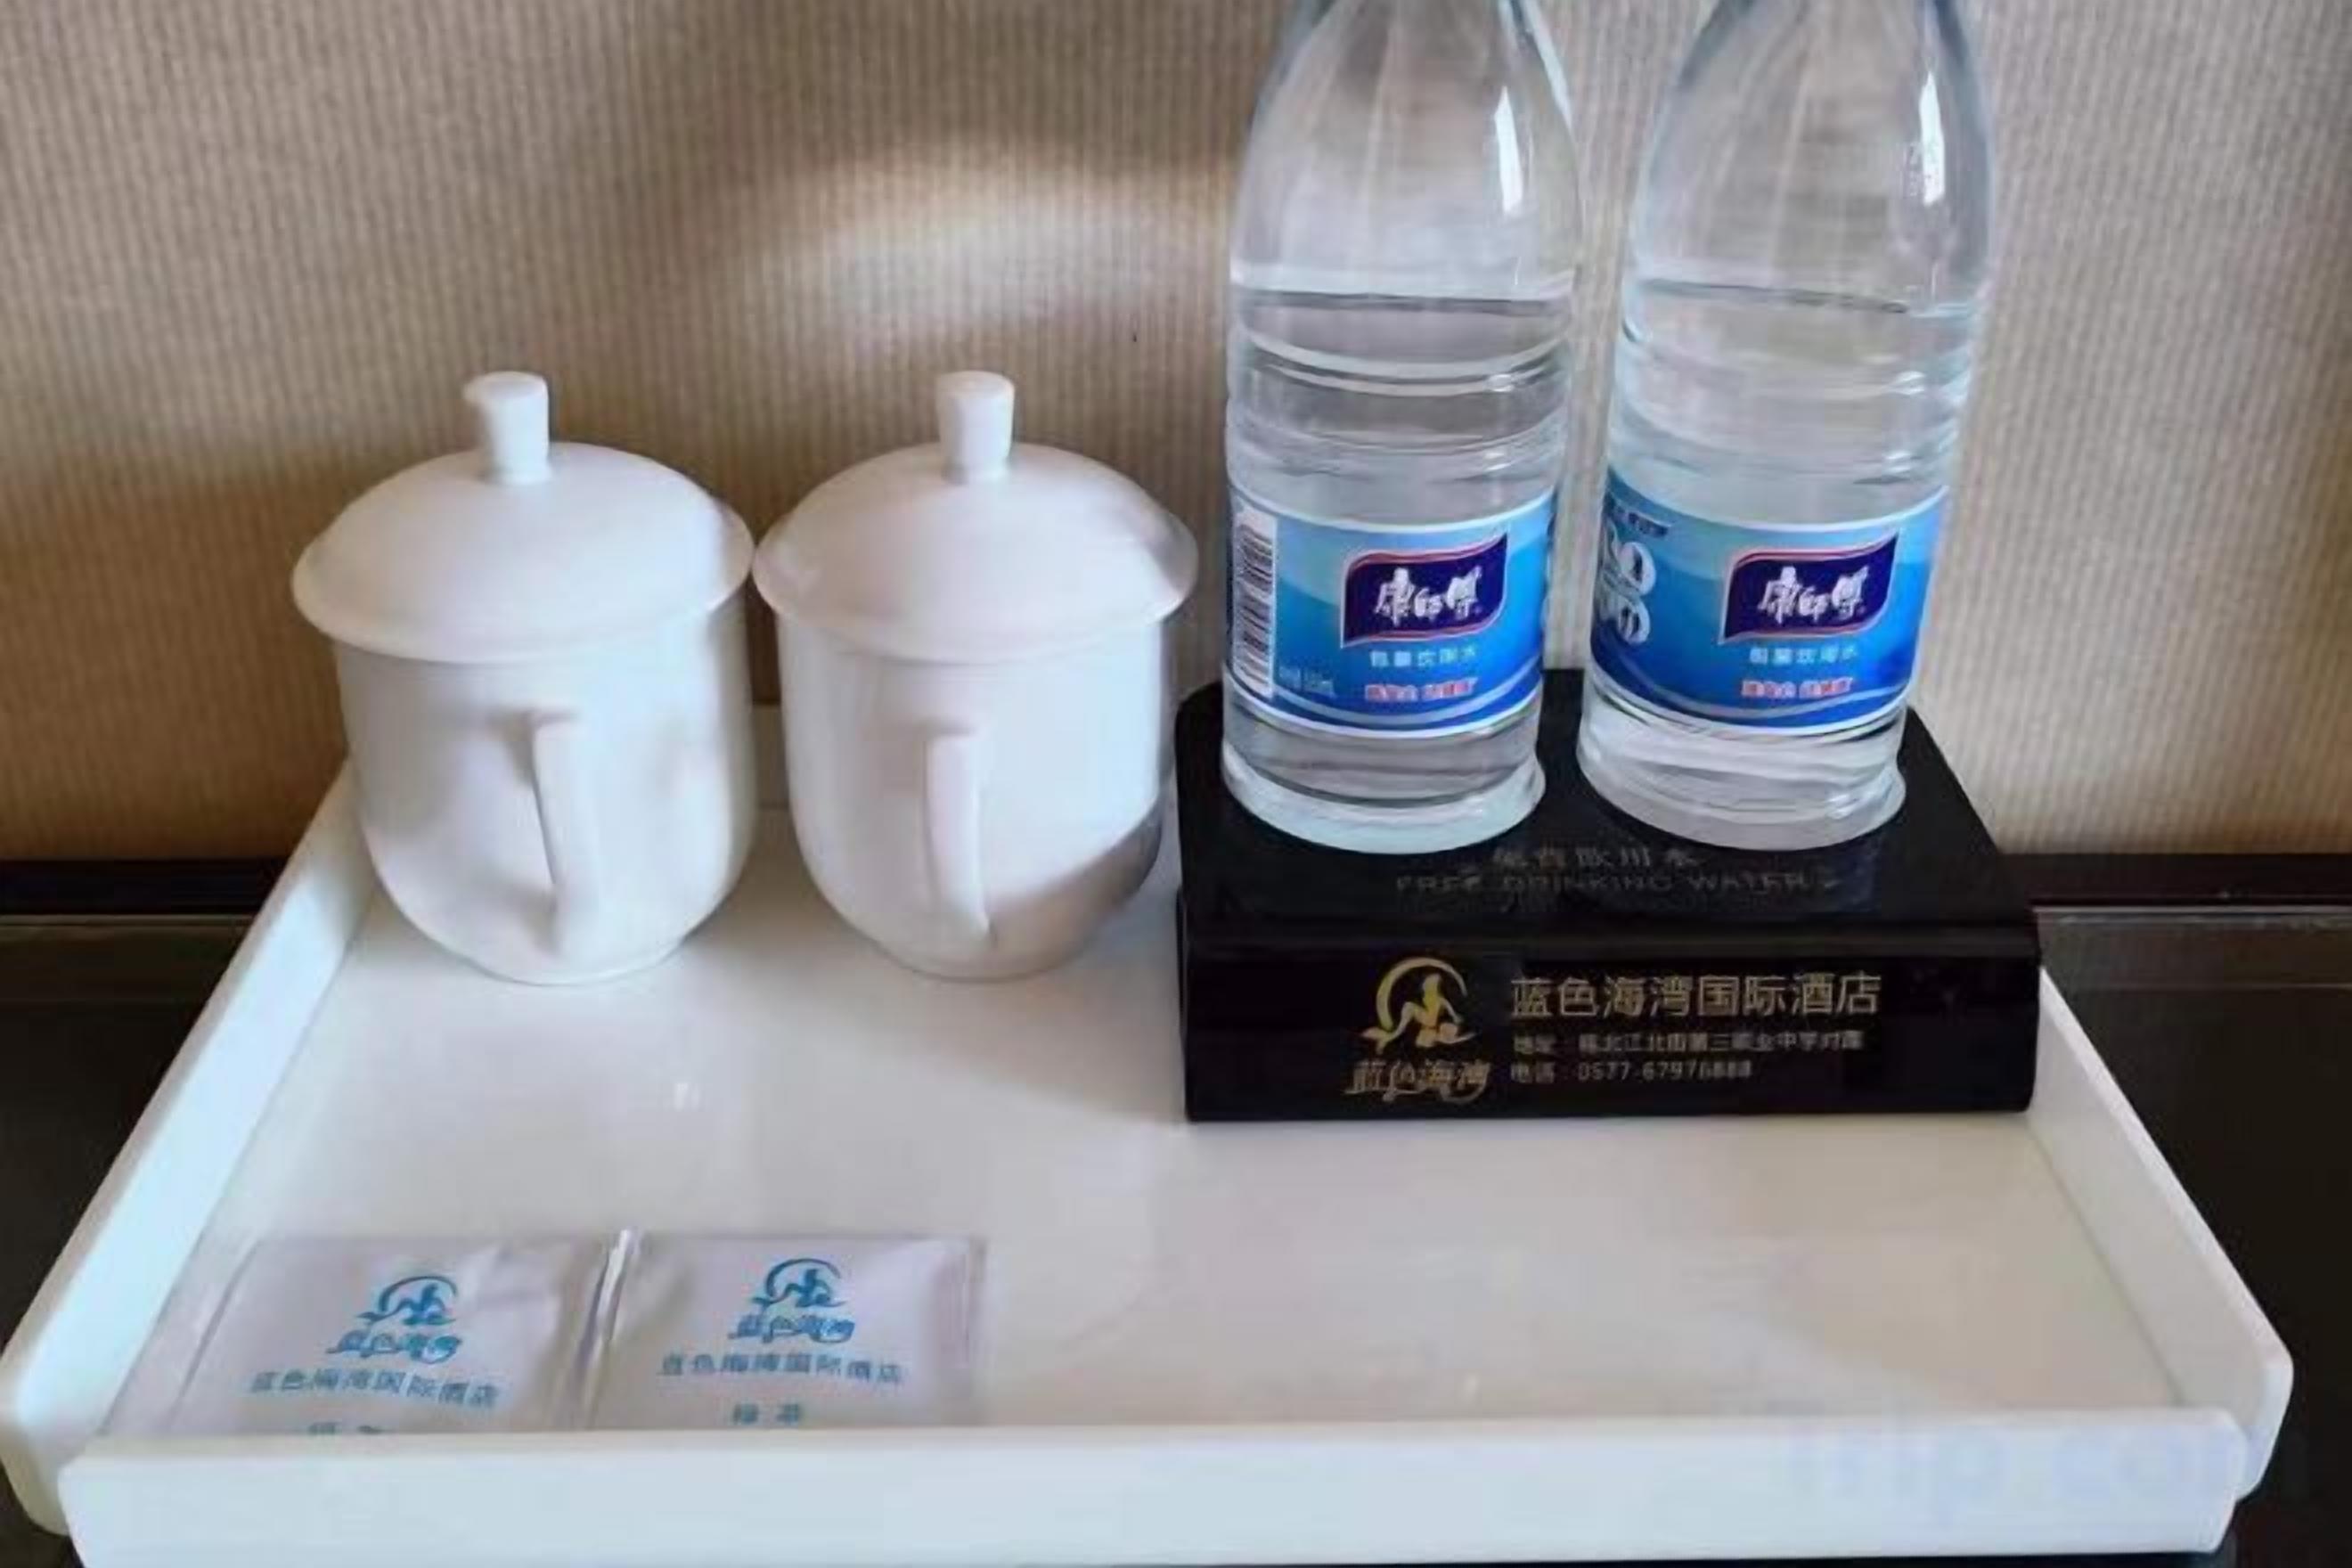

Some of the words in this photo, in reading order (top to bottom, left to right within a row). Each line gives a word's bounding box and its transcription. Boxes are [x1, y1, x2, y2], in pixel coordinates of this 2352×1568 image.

[1373, 567, 1483, 626] 康师傅
[1757, 565, 1869, 624] 康师傅
[1510, 973, 1882, 1017] 蓝色海湾国际酒店
[1343, 1058, 1491, 1103] 蓝色海湾
